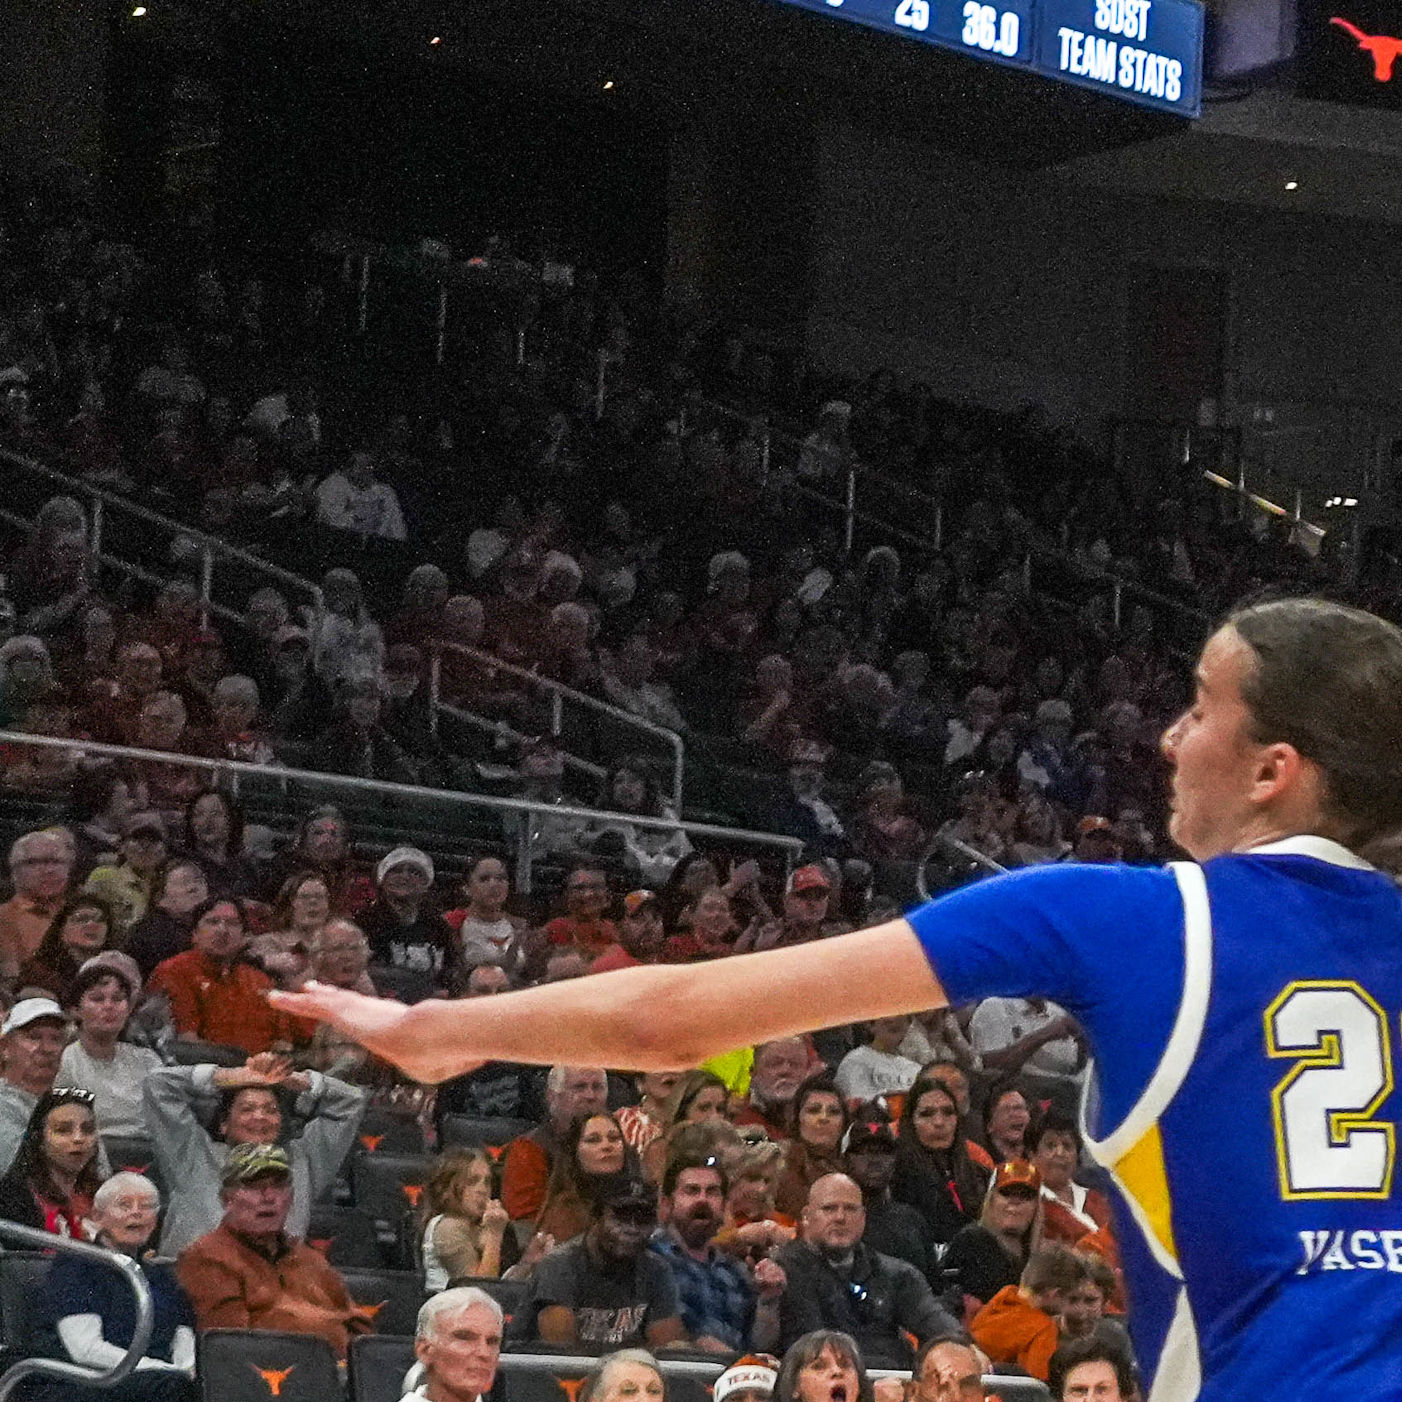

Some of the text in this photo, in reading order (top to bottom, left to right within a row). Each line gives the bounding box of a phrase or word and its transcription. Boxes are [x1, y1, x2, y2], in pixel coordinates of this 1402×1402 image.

[962, 1, 1020, 57] 36.0
[1095, 0, 1151, 42] SDST
[1058, 27, 1183, 102] TEAM STATS
[727, 1370, 772, 1387] TEXAS
